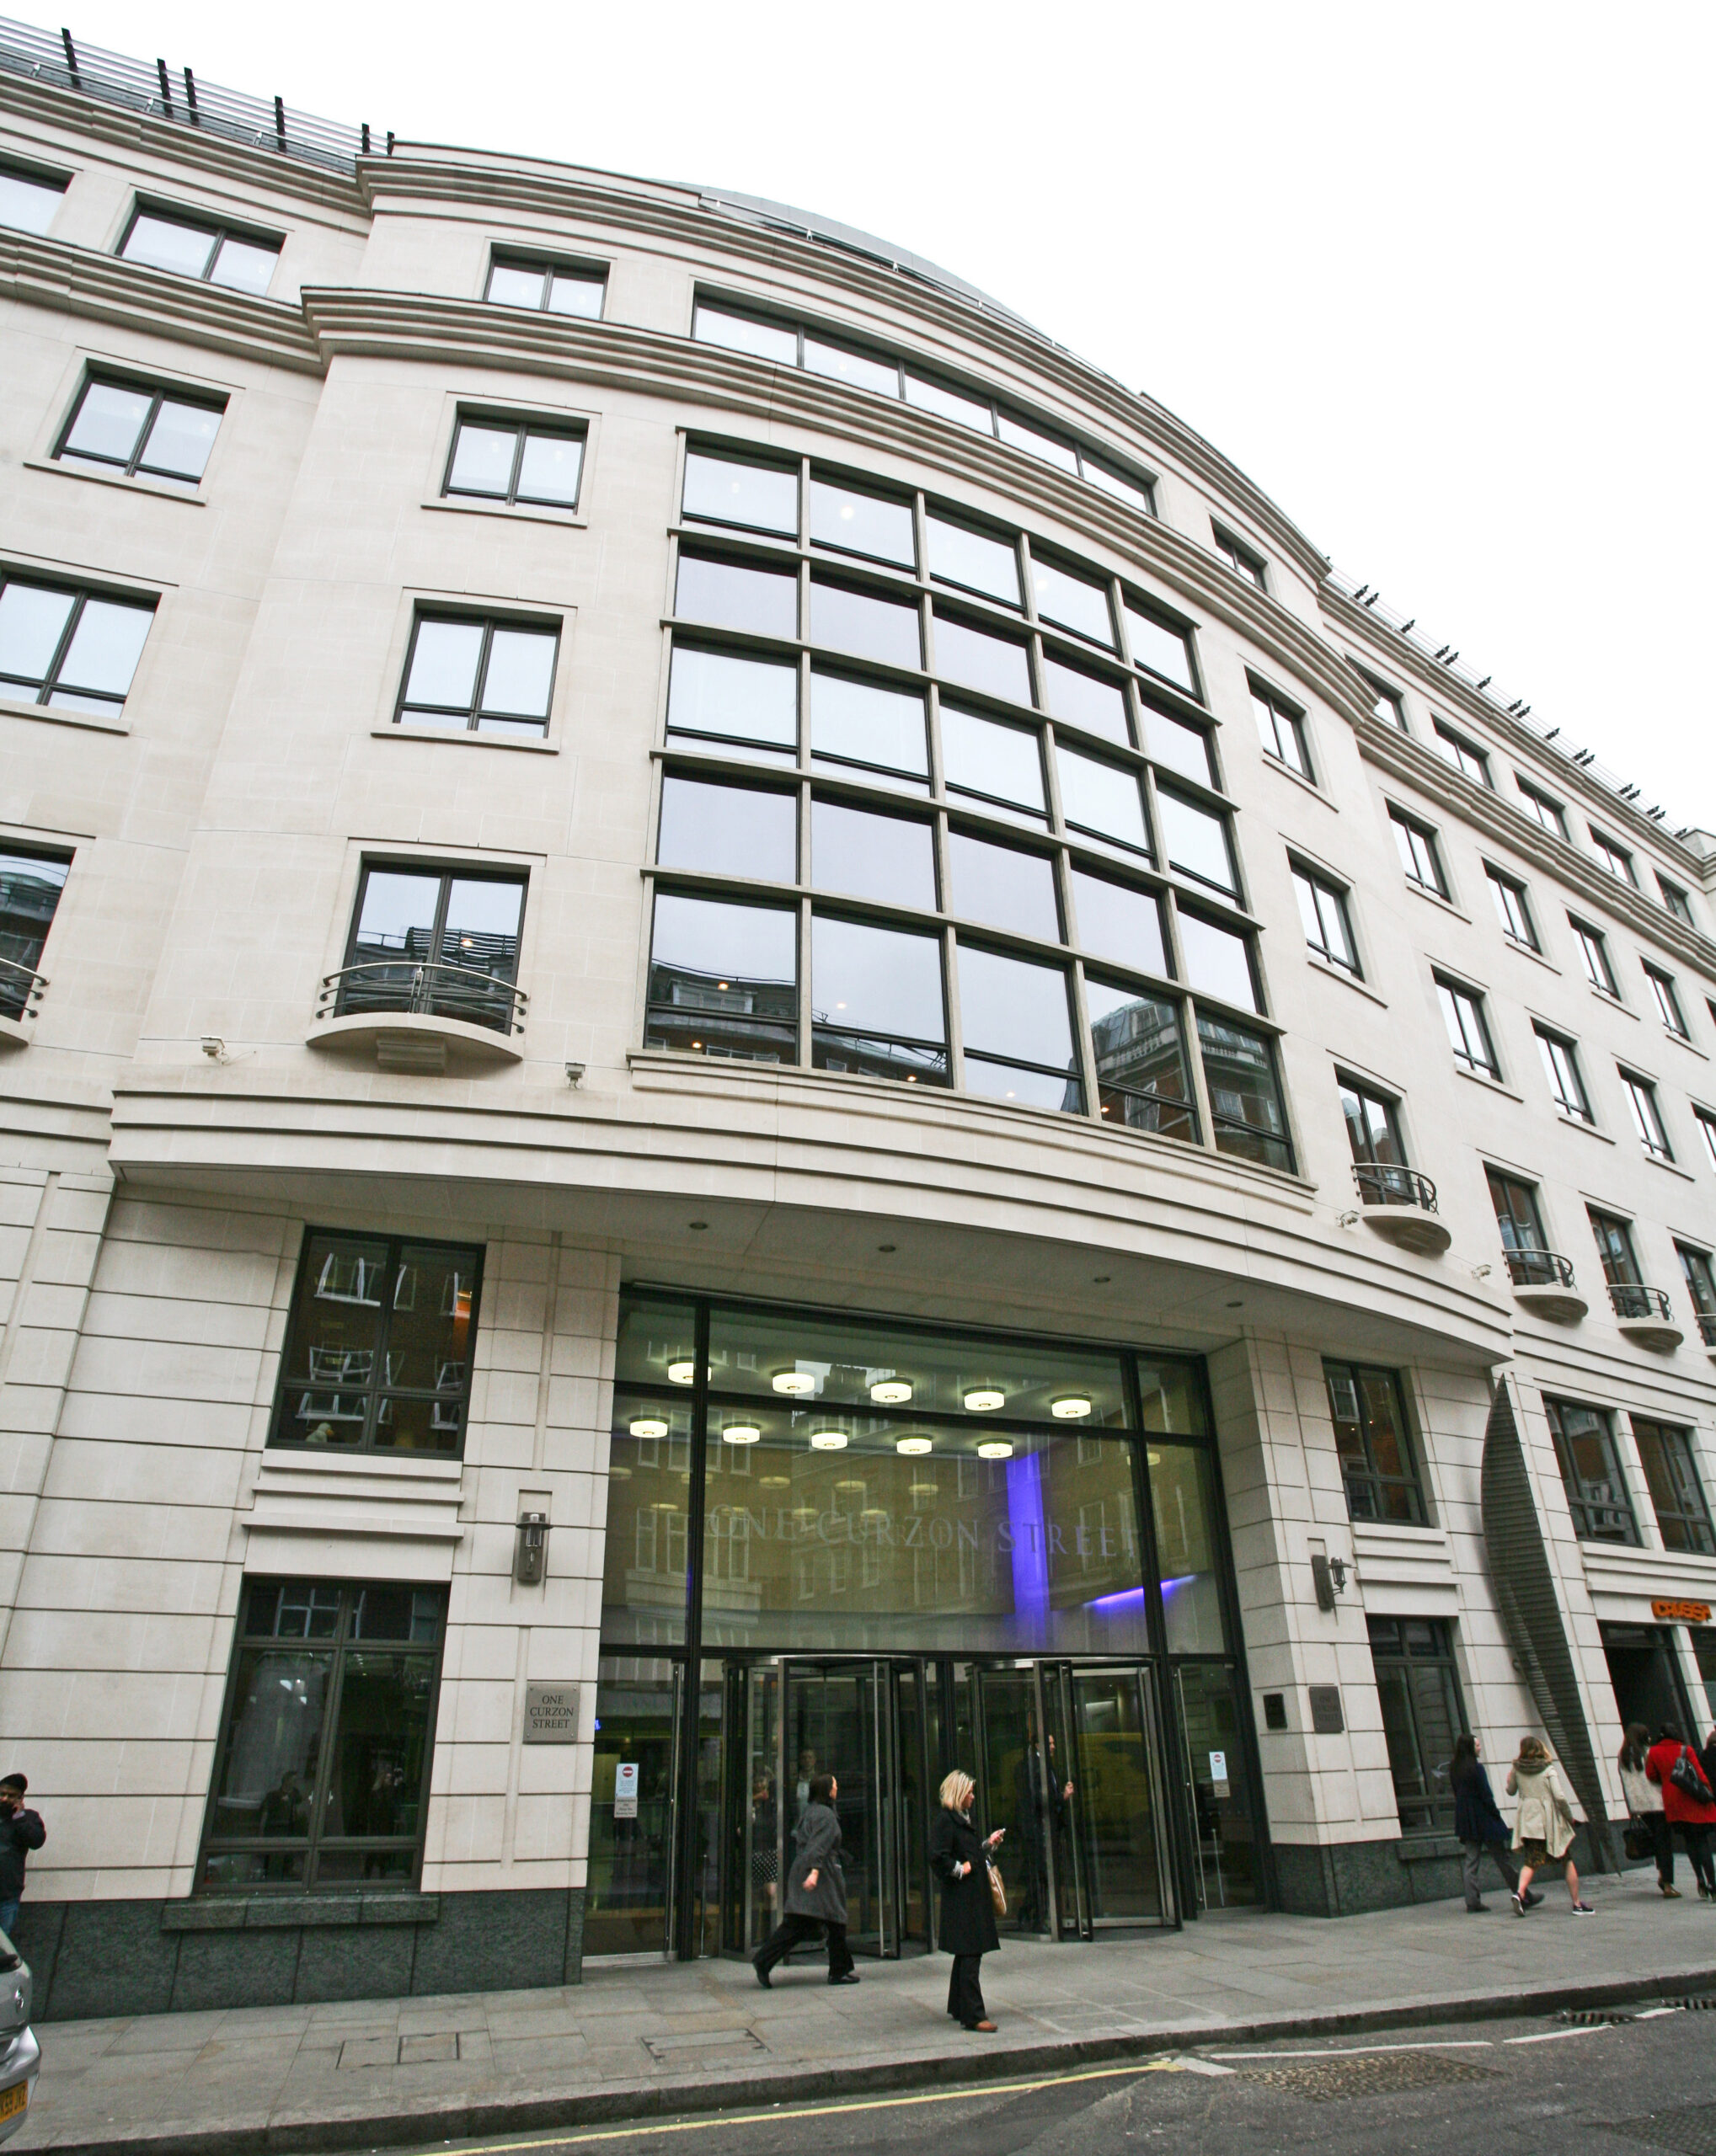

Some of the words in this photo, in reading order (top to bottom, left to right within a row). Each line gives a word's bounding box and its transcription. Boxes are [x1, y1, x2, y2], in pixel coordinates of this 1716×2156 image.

[708, 1504, 797, 1541] ONE
[816, 1511, 980, 1550] CURZON
[997, 1519, 1139, 1558] STREET
[542, 1695, 564, 1705] ONE
[530, 1706, 575, 1717] CURZON
[532, 1719, 570, 1729] STREET
